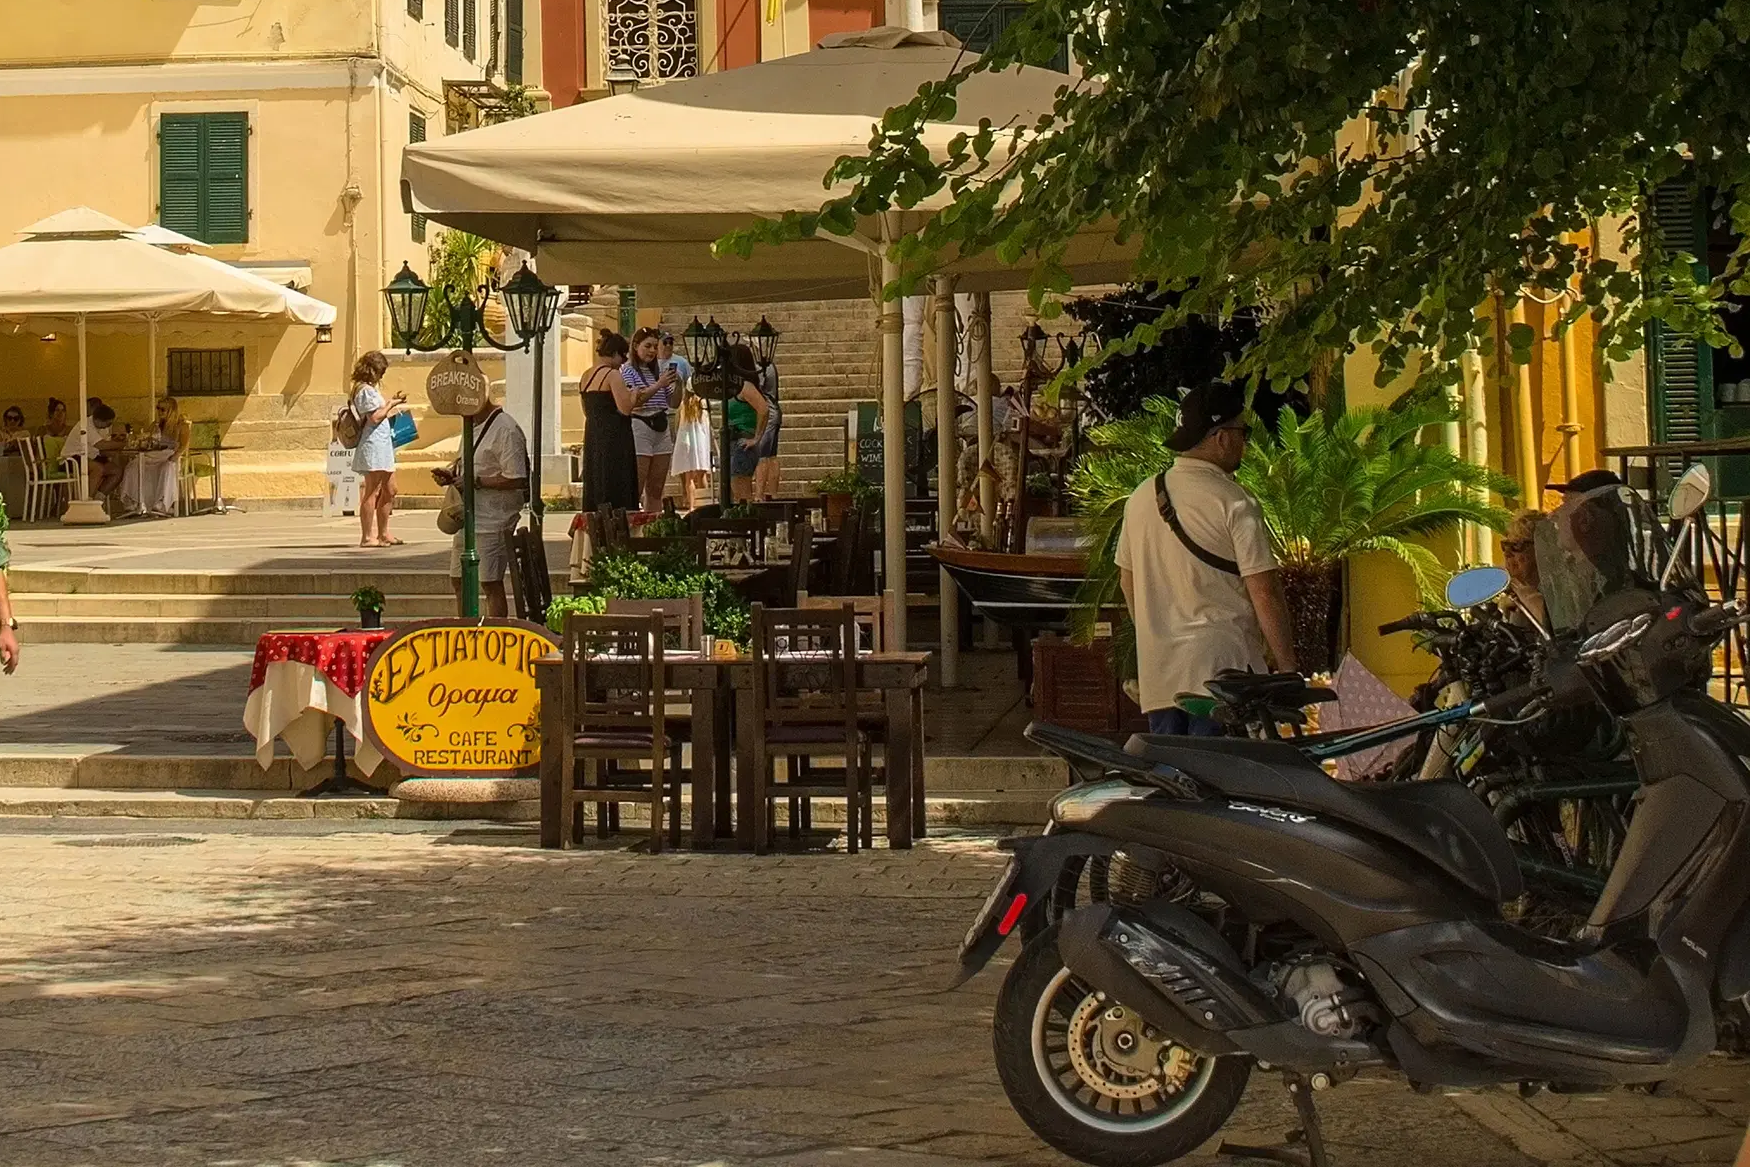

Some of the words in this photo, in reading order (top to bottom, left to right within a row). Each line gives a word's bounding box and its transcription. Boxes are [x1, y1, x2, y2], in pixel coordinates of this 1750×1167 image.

[430, 371, 481, 392] BREAKFAST
[456, 394, 479, 406] Orama
[379, 630, 549, 704] ΕΣΤΙΑΤΟΡΙΟ
[449, 731, 497, 747] CAFE
[414, 749, 533, 765] RESTAURANT
